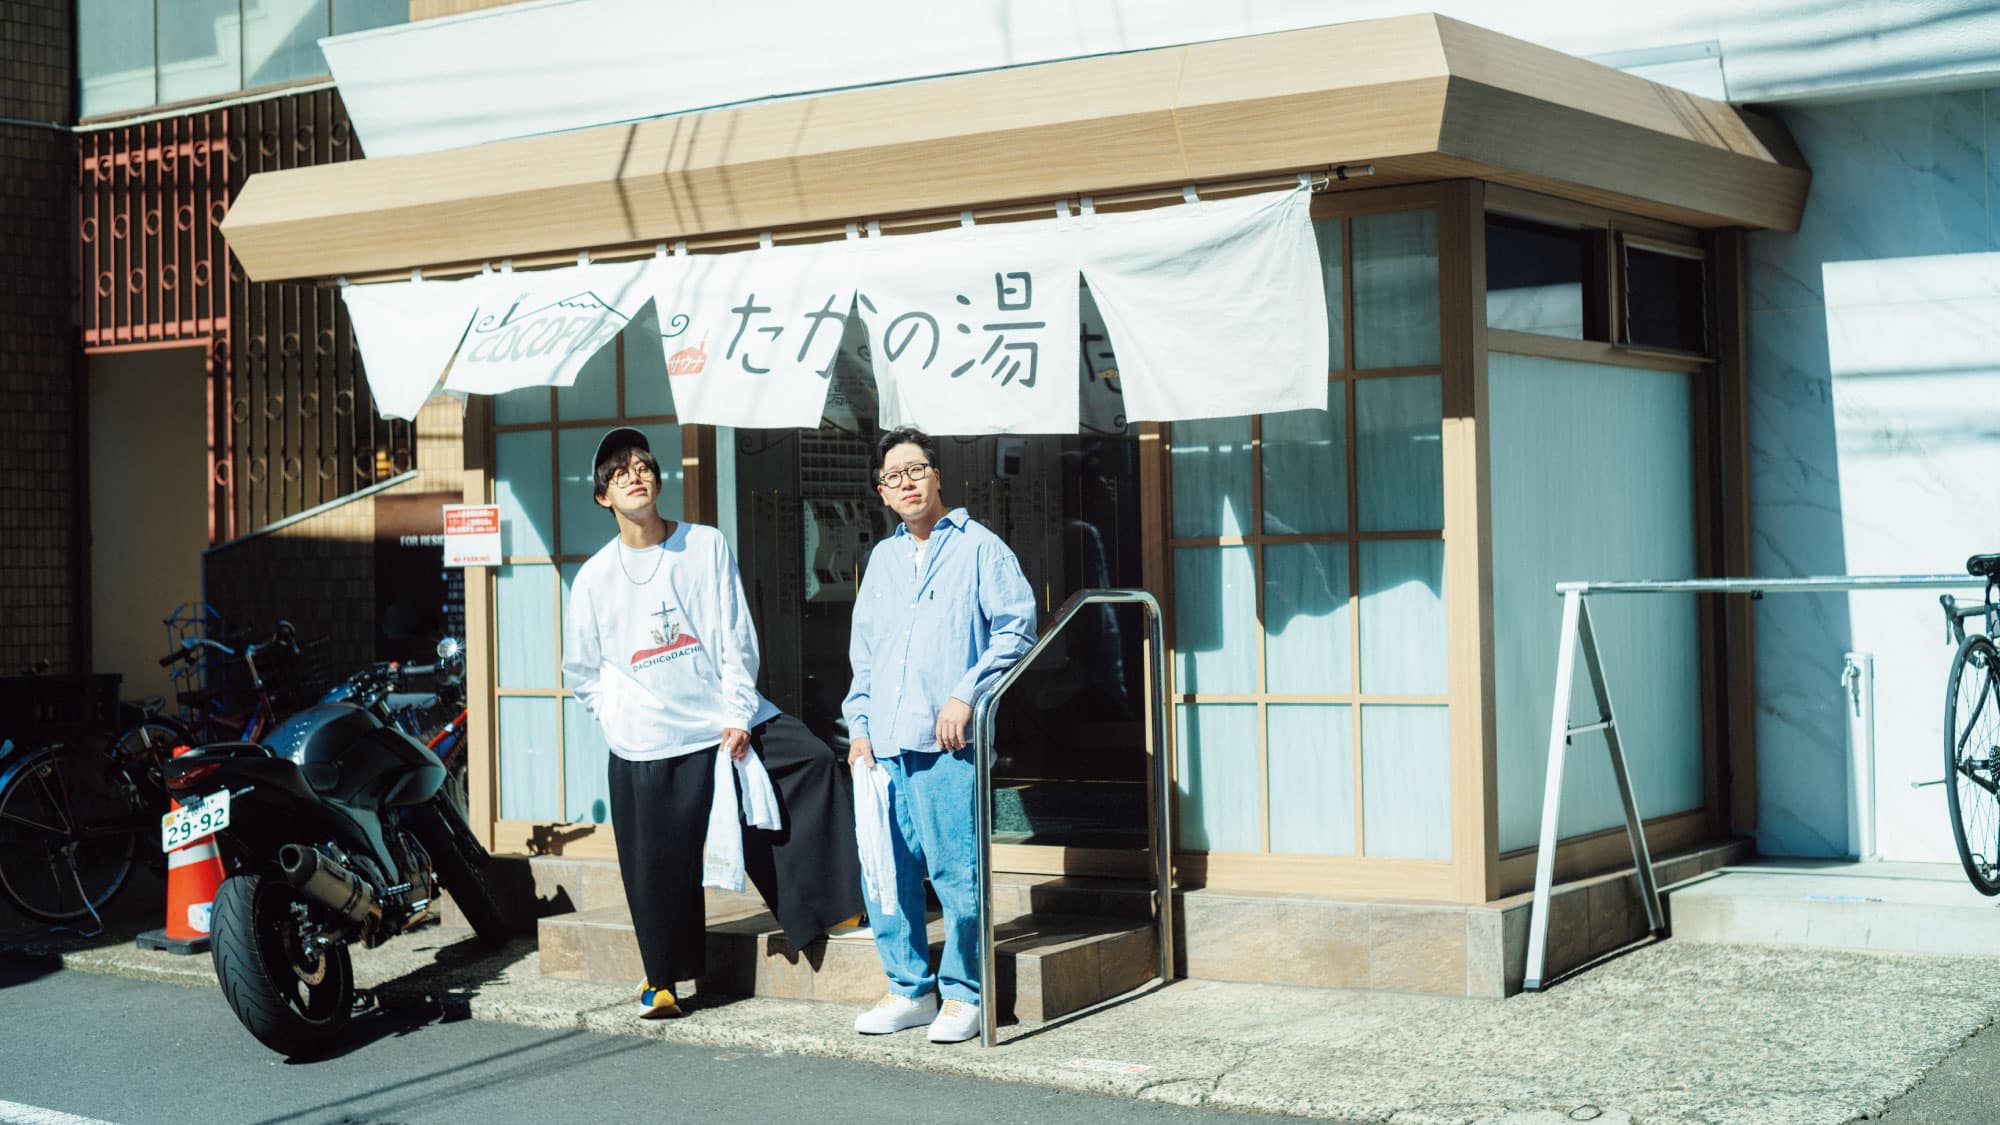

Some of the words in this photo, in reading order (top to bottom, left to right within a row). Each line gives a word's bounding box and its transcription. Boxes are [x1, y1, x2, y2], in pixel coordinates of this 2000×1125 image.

[725, 271, 1046, 388] たかの湯
[400, 535, 419, 546] FOR
[168, 808, 225, 846] 29-92
